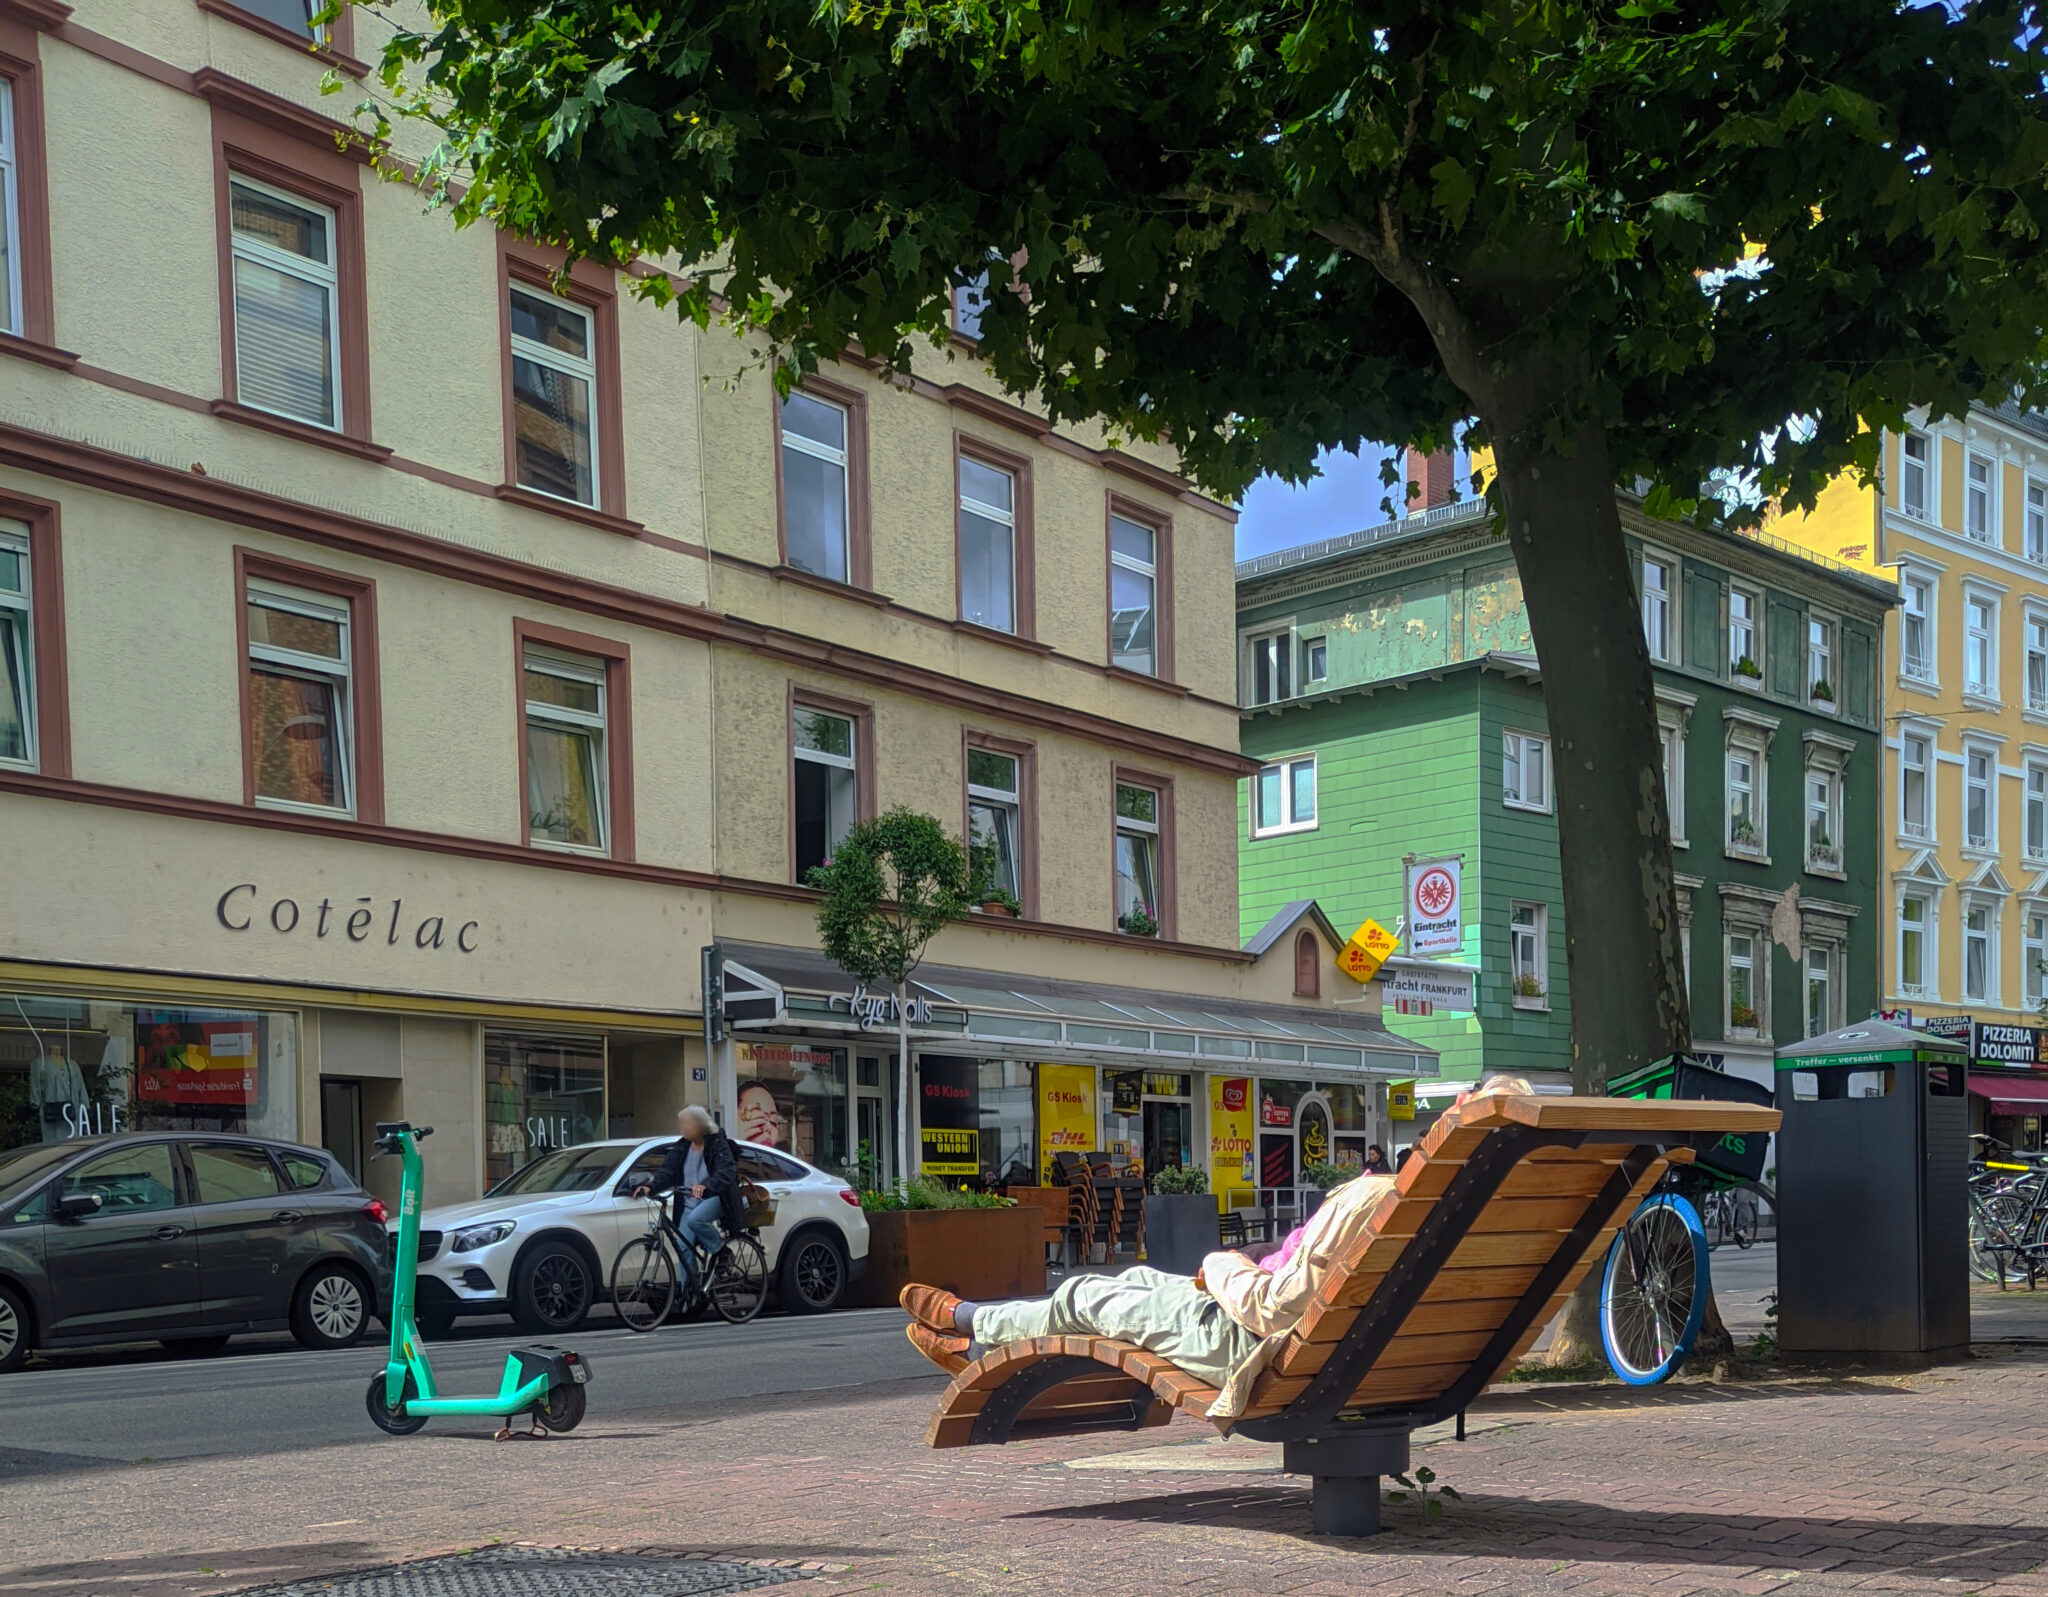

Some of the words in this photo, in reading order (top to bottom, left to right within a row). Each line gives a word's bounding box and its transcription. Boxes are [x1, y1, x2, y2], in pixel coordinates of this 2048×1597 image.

[1414, 919, 1457, 932] Eintracht
[1365, 941, 1390, 950] LOTTO
[1423, 936, 1458, 947] Sporthalle
[1348, 963, 1372, 972] LOTTO
[1421, 985, 1468, 997] FRANKFURT
[1928, 1016, 1969, 1025] PIZZERIA
[1926, 1024, 1971, 1033] DOLOMITI
[1983, 1026, 2032, 1044] PIZZERIA
[1980, 1043, 2035, 1061] DOLOMITI
[1795, 1058, 1826, 1067] Treffer
[1839, 1053, 1882, 1064] versenkt!
[695, 1069, 706, 1080] 31
[925, 1085, 939, 1096] GS
[943, 1085, 970, 1098] Kiosk
[1048, 1092, 1060, 1103] GS
[1063, 1093, 1087, 1104] Kiosk
[62, 1102, 122, 1139] SALE
[527, 1116, 568, 1148] SALE
[922, 1133, 968, 1142] WESTERN
[1050, 1132, 1087, 1145] DHL
[937, 1144, 968, 1153] UNION
[1223, 1138, 1251, 1152] LOTTO
[404, 1189, 416, 1216] Bolt
